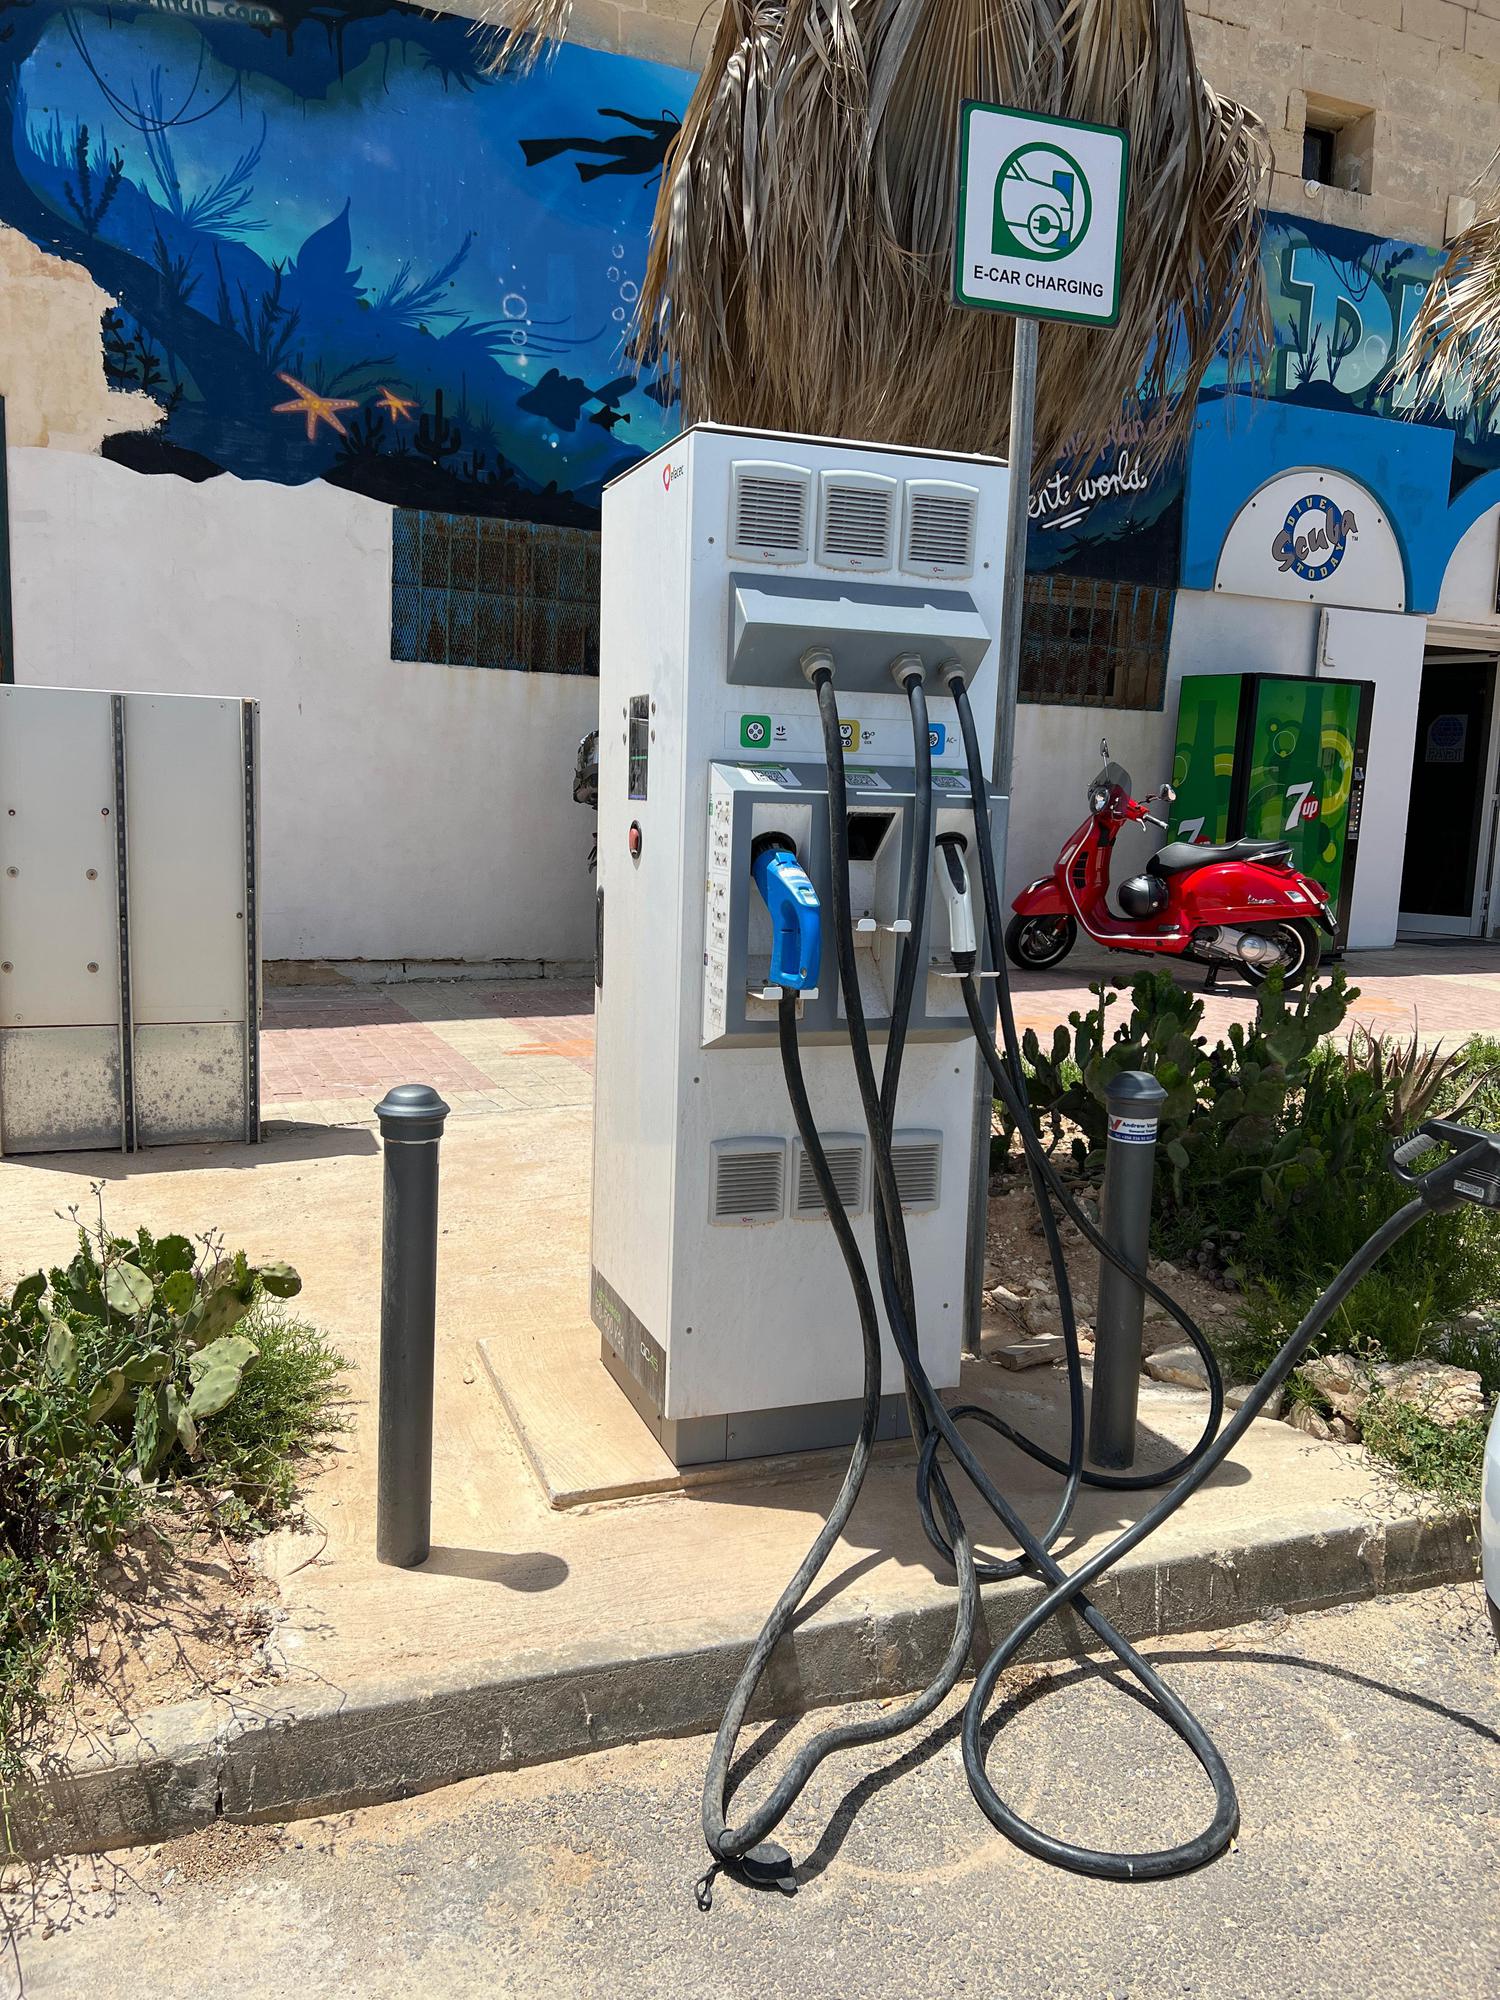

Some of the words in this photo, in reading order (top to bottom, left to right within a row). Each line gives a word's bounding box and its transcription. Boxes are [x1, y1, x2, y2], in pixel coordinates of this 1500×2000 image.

[973, 265, 1021, 285] E-CAR
[1025, 273, 1104, 297] CHARGING
[1287, 497, 1327, 526] DIVE
[1271, 509, 1358, 572] Scuba
[1296, 542, 1343, 579] TODAY
